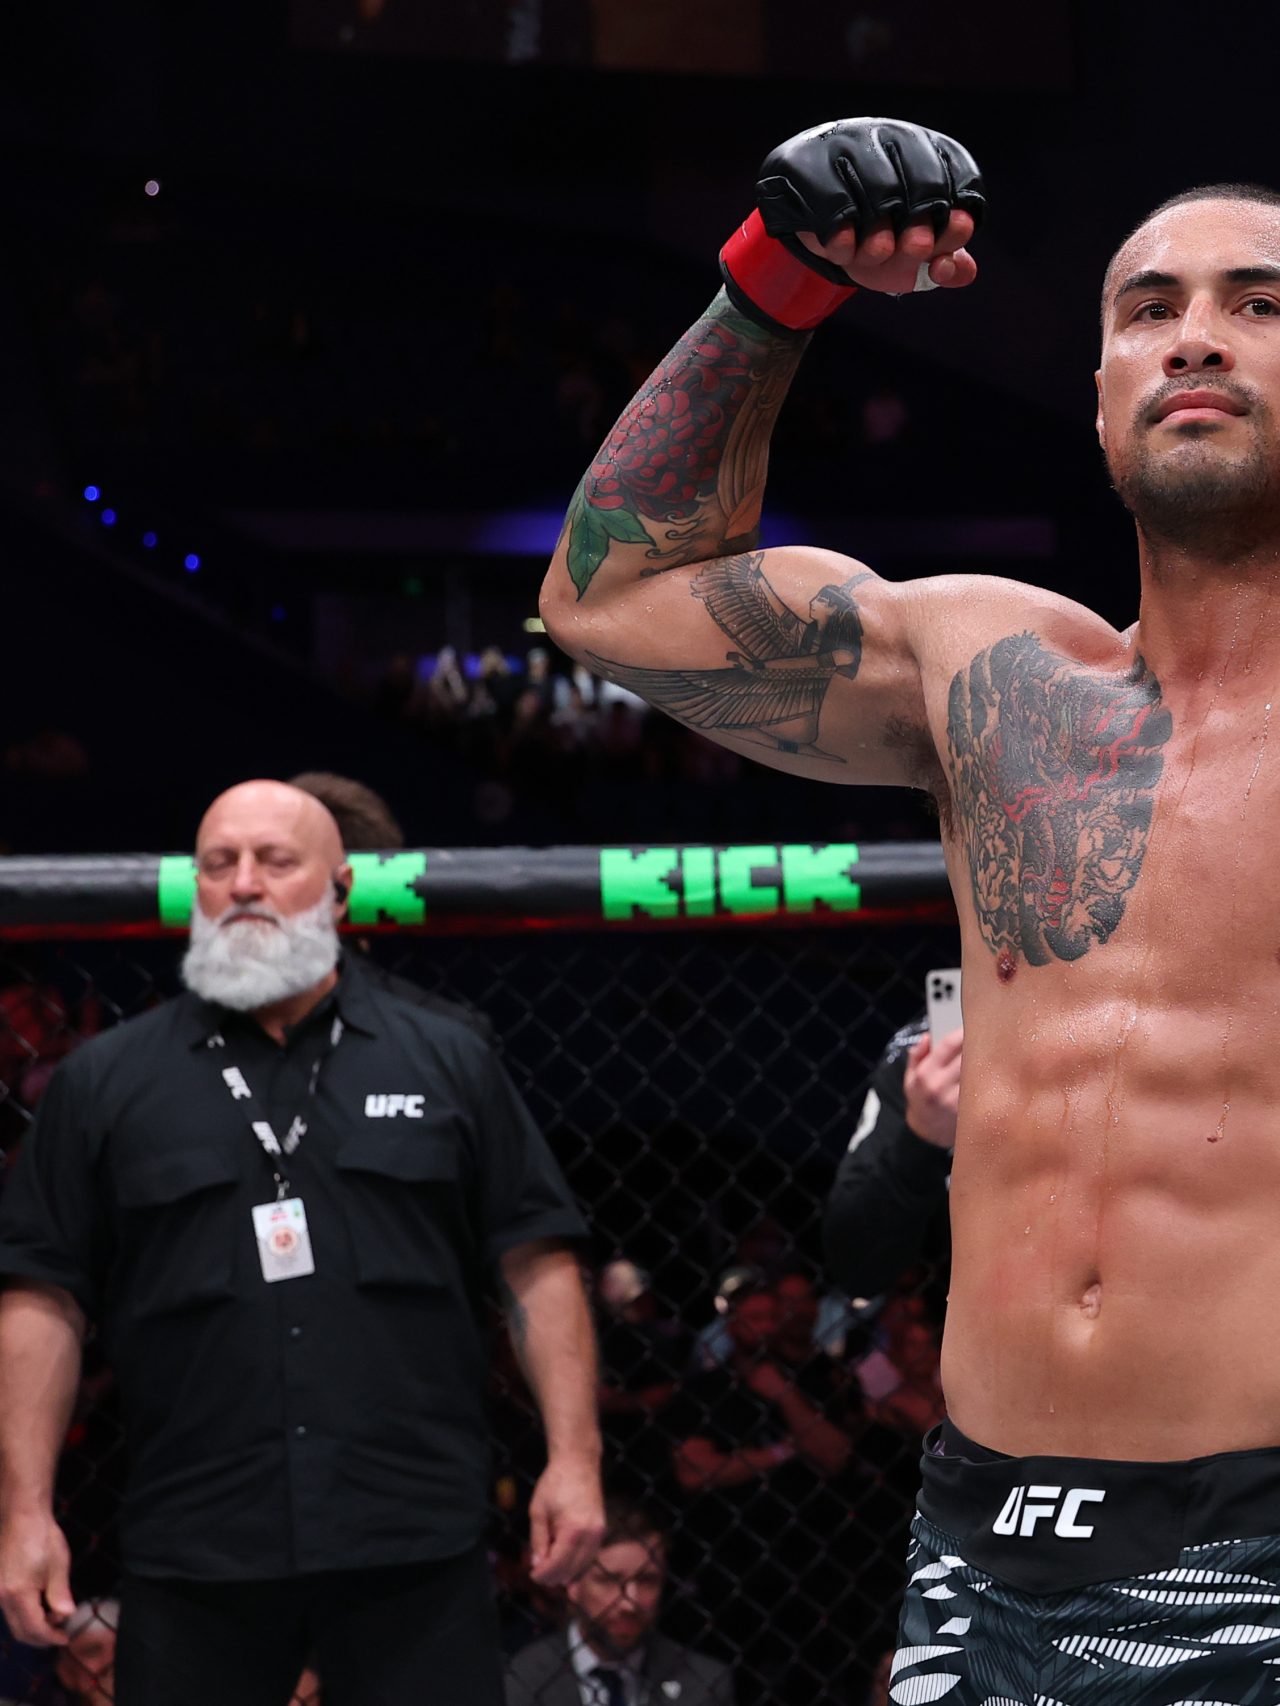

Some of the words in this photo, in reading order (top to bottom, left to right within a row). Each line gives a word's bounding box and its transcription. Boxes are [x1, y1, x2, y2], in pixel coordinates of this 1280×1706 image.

[600, 843, 860, 920] KICK
[364, 1094, 425, 1118] UFC
[992, 1485, 1106, 1538] UFC
